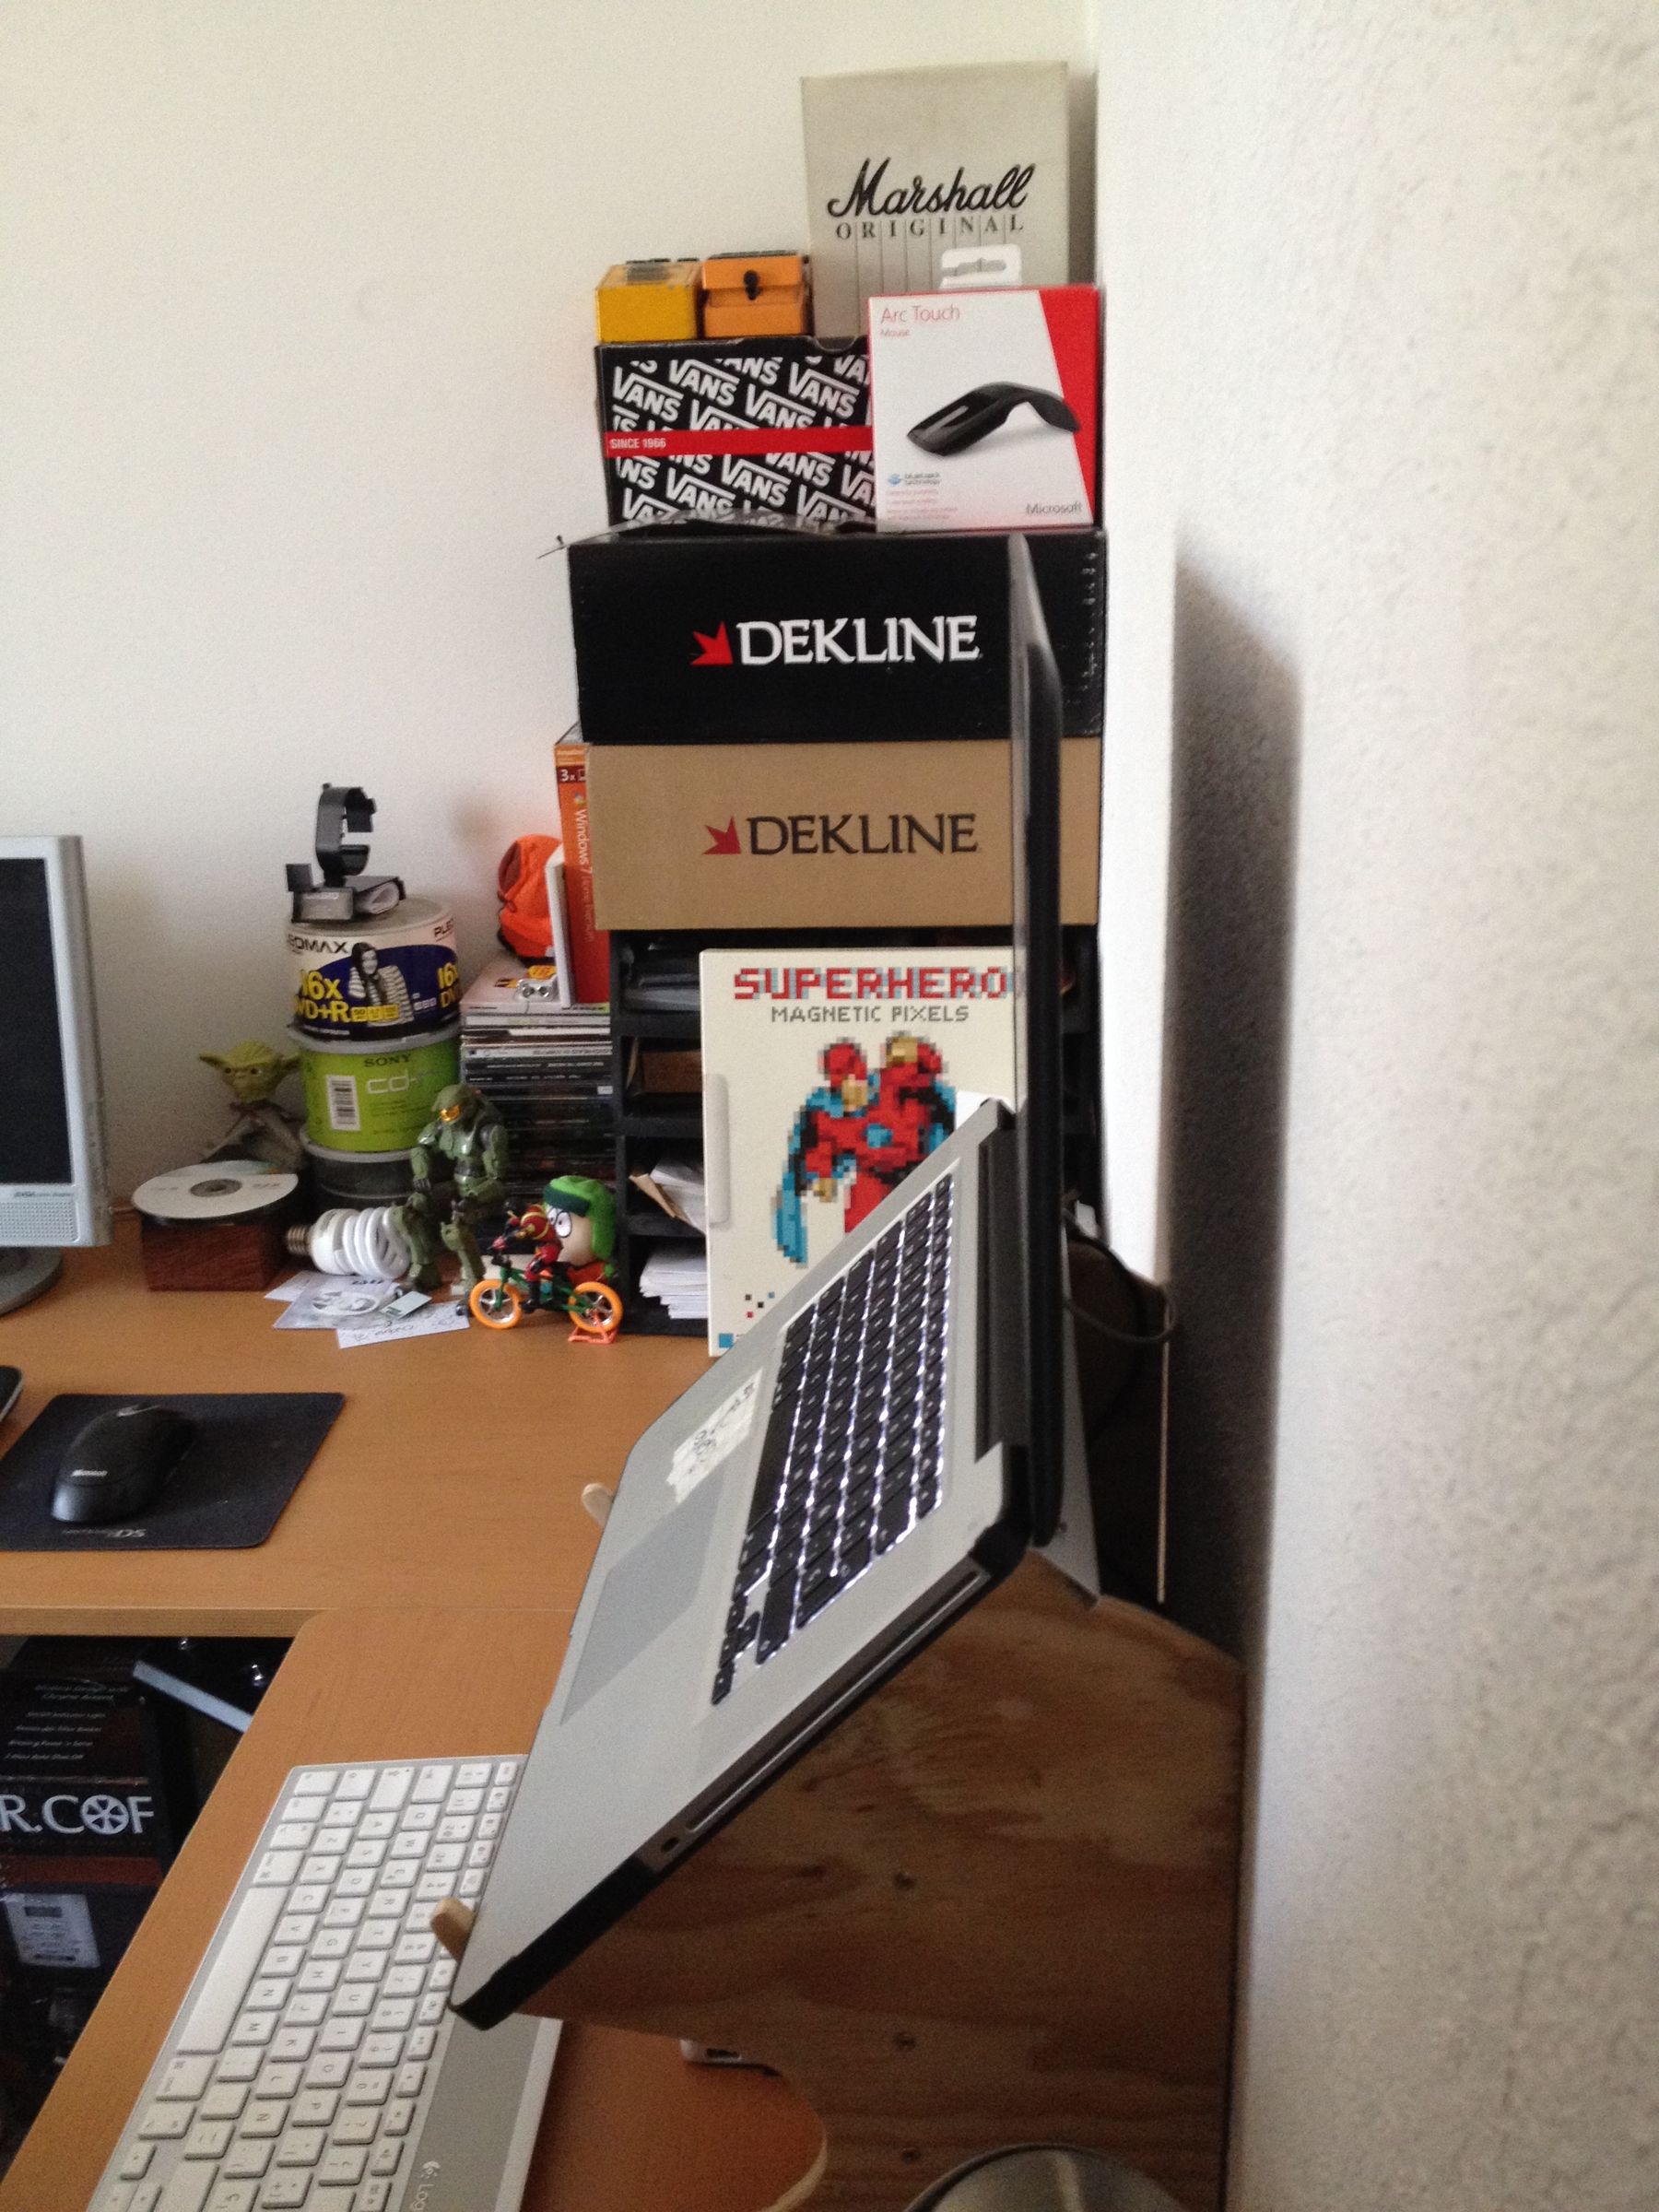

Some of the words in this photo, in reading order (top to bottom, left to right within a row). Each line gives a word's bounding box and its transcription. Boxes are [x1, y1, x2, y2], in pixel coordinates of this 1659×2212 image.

[827, 157, 1036, 218] Marshall
[835, 214, 1024, 240] ORIGINAL
[880, 307, 908, 324] Arc
[912, 303, 959, 322] Touch
[613, 366, 684, 422] VANS
[668, 359, 739, 407] VANS
[789, 361, 860, 418] VANS
[610, 439, 640, 450] SINCE
[642, 438, 666, 449] 1966
[722, 453, 791, 507] VANS
[1026, 500, 1082, 514] Microsoft
[735, 615, 981, 665] DEKLINE
[573, 808, 587, 865] Windows
[747, 813, 980, 855] DEKLINE
[300, 969, 344, 1000] 16x
[735, 967, 1012, 999] SUPERHERO
[771, 1006, 882, 1023] MAGNETIC
[891, 1005, 970, 1022] PIXELS
[364, 1053, 411, 1067] SONY
